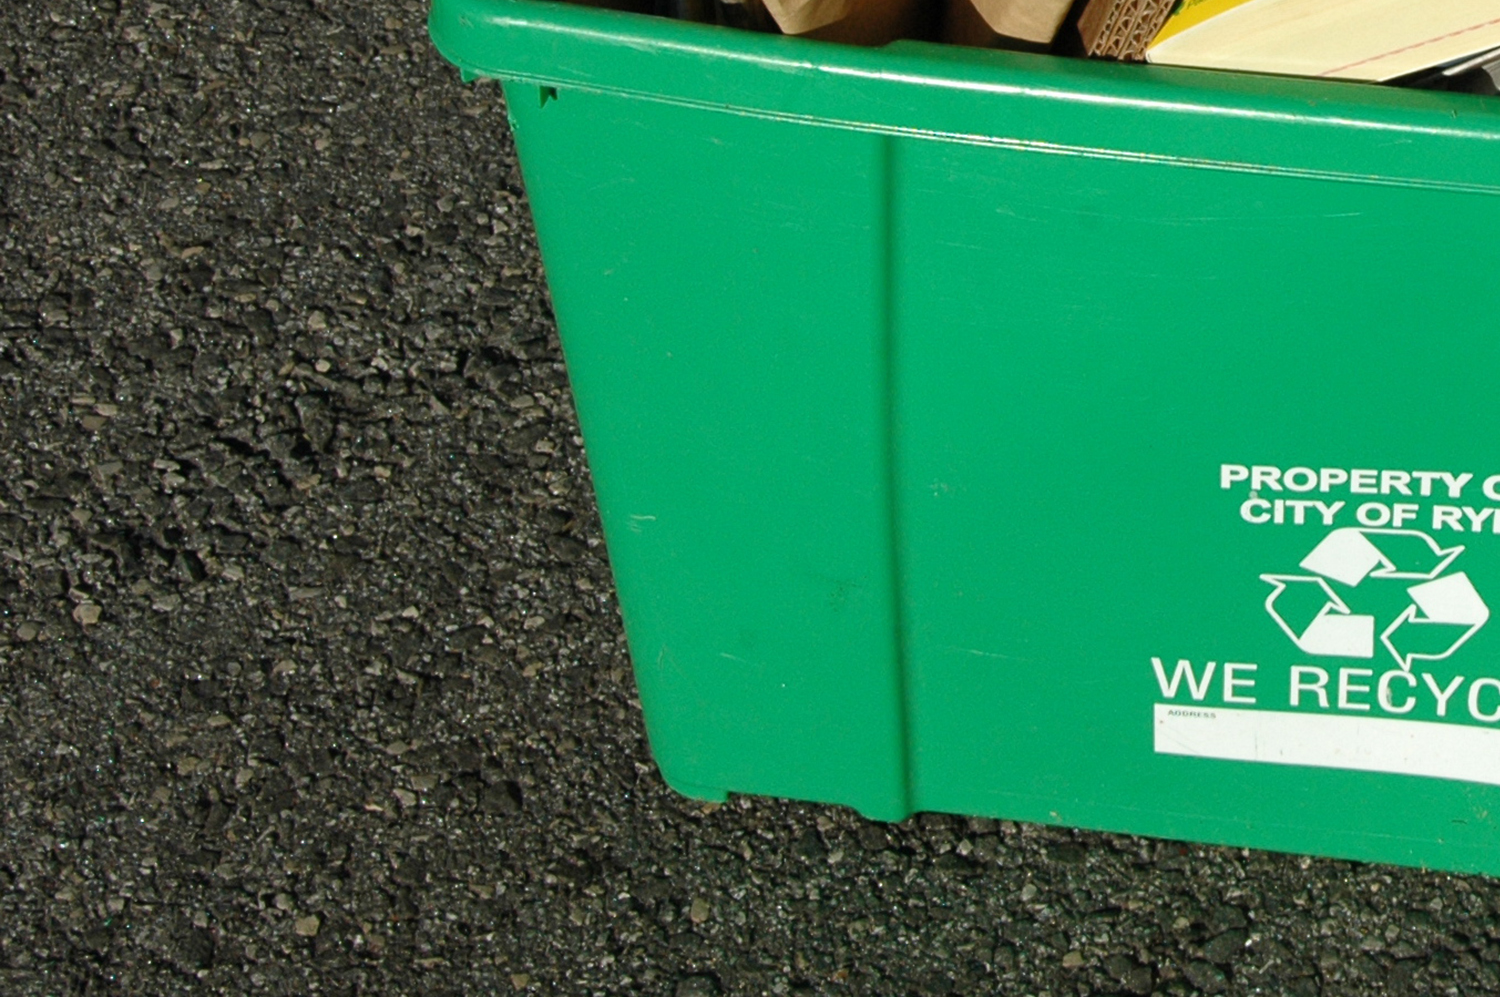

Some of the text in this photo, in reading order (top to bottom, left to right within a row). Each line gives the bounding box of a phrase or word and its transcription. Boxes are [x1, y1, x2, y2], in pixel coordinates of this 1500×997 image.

[1219, 463, 1475, 498] PROPERTY
[1239, 497, 1347, 526] CITY
[1355, 501, 1421, 528] OF
[1150, 656, 1259, 705] WE
[1166, 708, 1218, 720] ADDRESS
